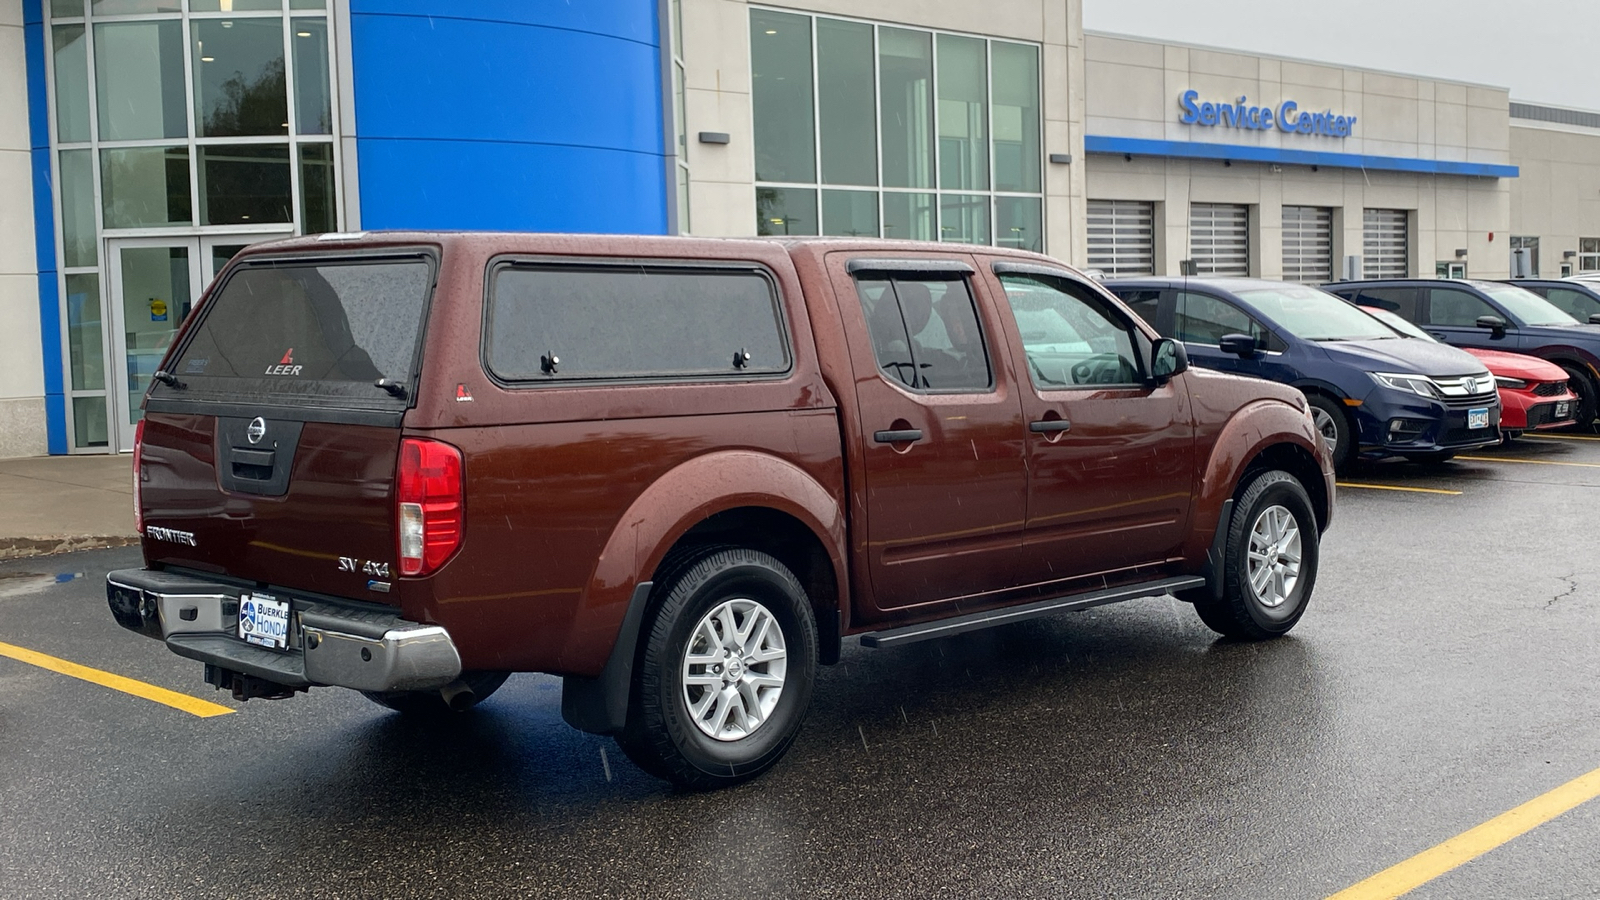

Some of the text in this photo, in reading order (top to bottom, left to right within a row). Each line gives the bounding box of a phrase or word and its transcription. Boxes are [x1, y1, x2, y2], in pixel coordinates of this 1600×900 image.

[1179, 89, 1357, 137] Service Center
[264, 364, 303, 376] LEER
[146, 525, 197, 547] FRONTIER
[338, 556, 358, 573] SV
[256, 614, 287, 637] HONDA
